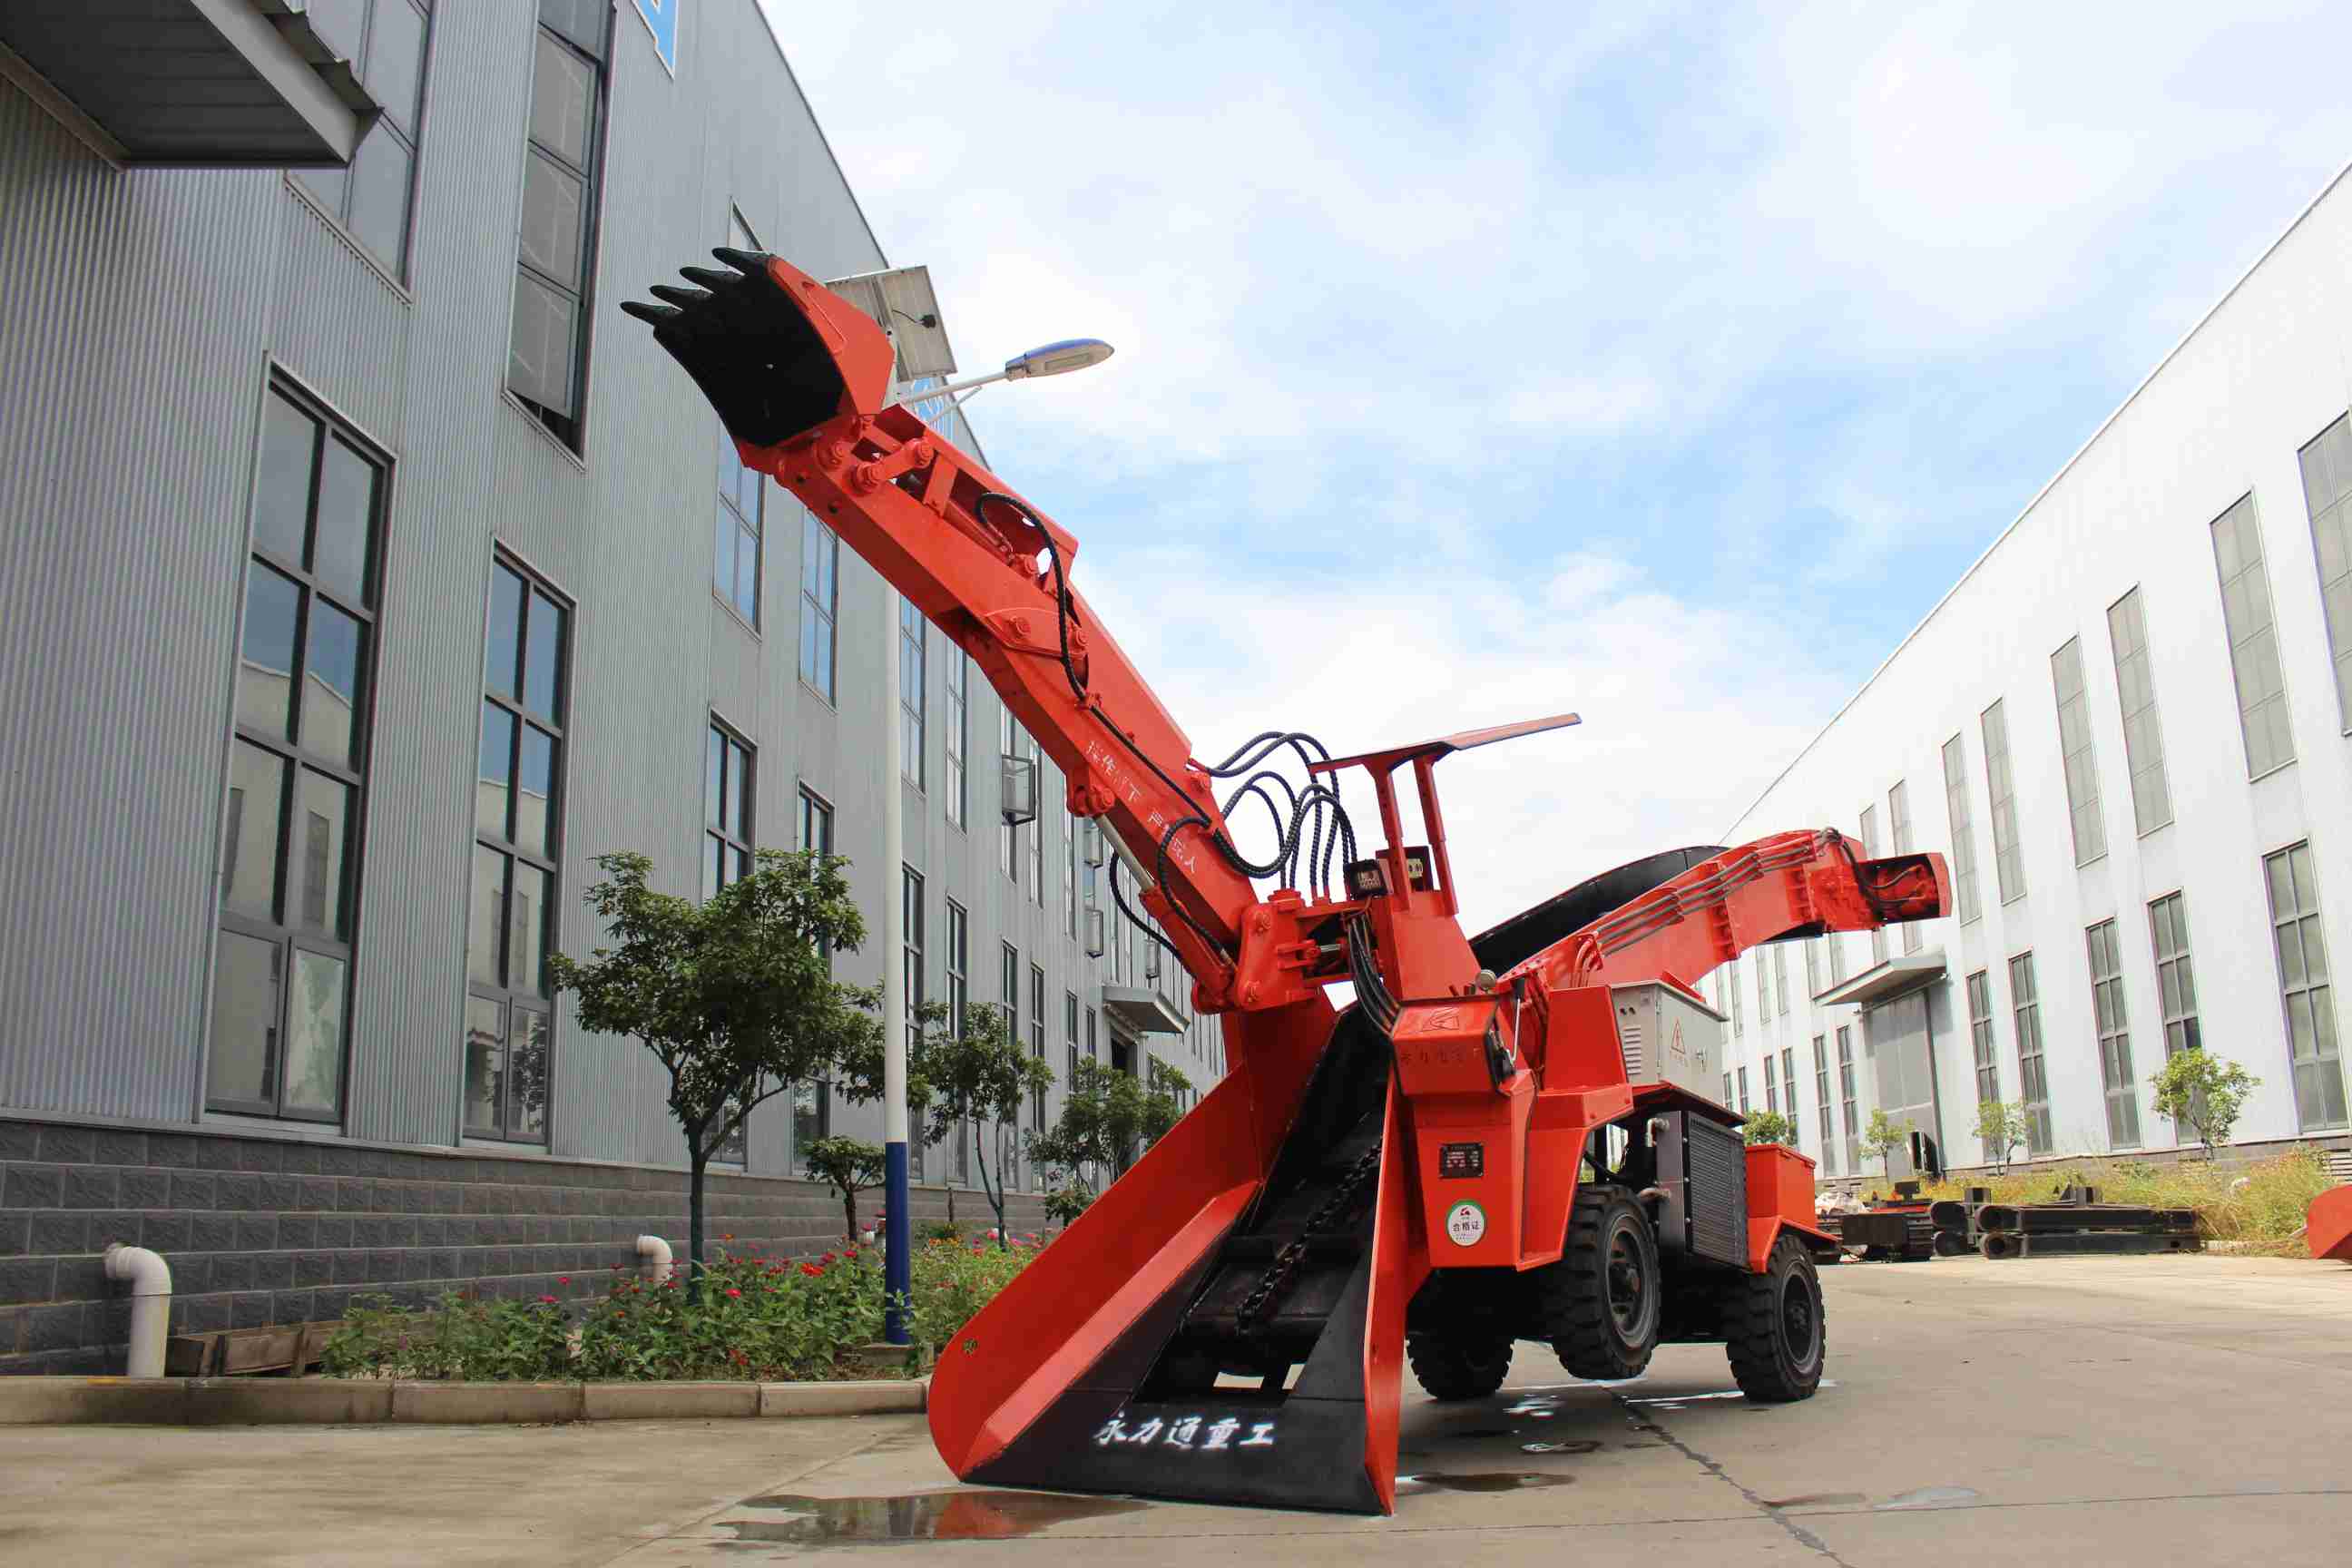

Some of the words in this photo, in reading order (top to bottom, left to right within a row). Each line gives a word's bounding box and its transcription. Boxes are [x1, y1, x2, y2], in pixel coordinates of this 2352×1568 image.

[1093, 1410, 1275, 1449] 永力通重工
